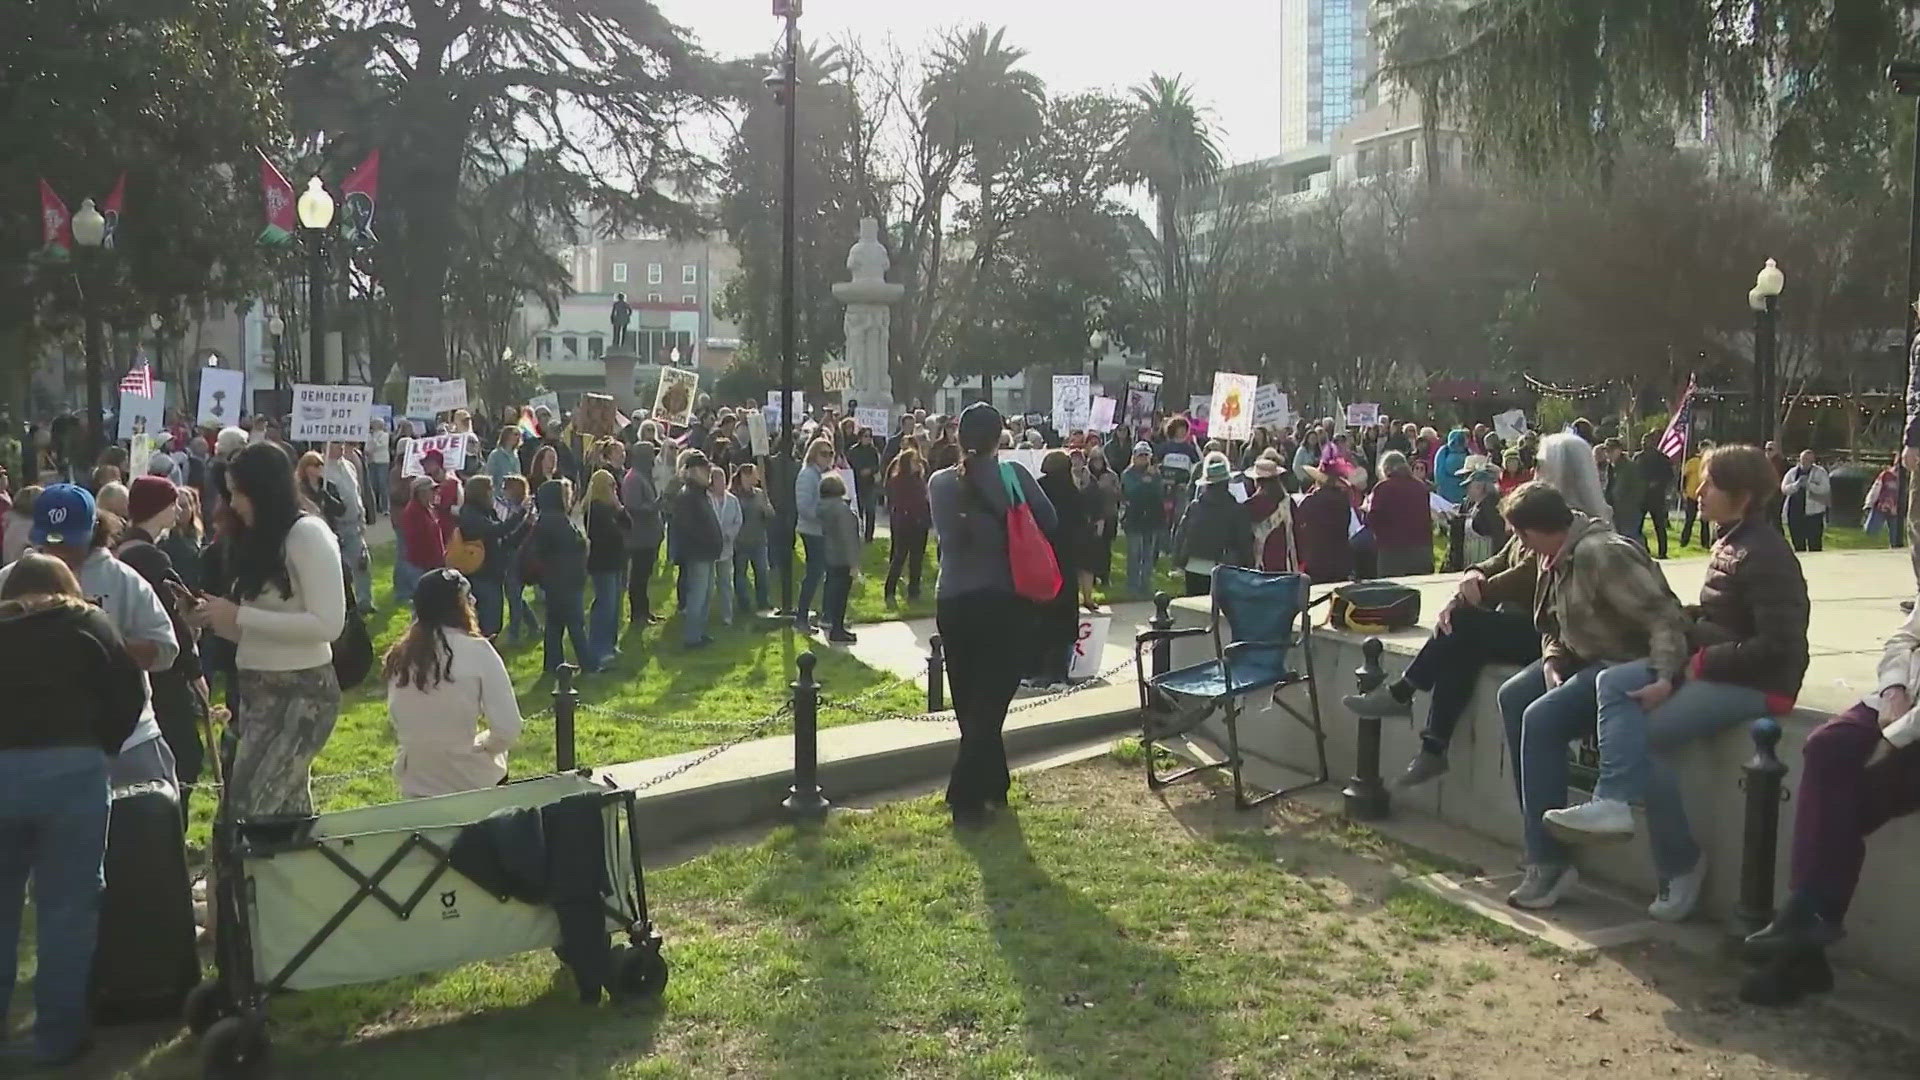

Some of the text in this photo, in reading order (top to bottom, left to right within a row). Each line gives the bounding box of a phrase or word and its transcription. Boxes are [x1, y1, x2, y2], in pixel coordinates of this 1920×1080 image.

[301, 390, 367, 403] DEMOCRACY
[331, 408, 352, 418] NOT
[300, 424, 362, 436] AUTOCRACY
[412, 437, 460, 454] LOVE
[48, 507, 67, 524] W
